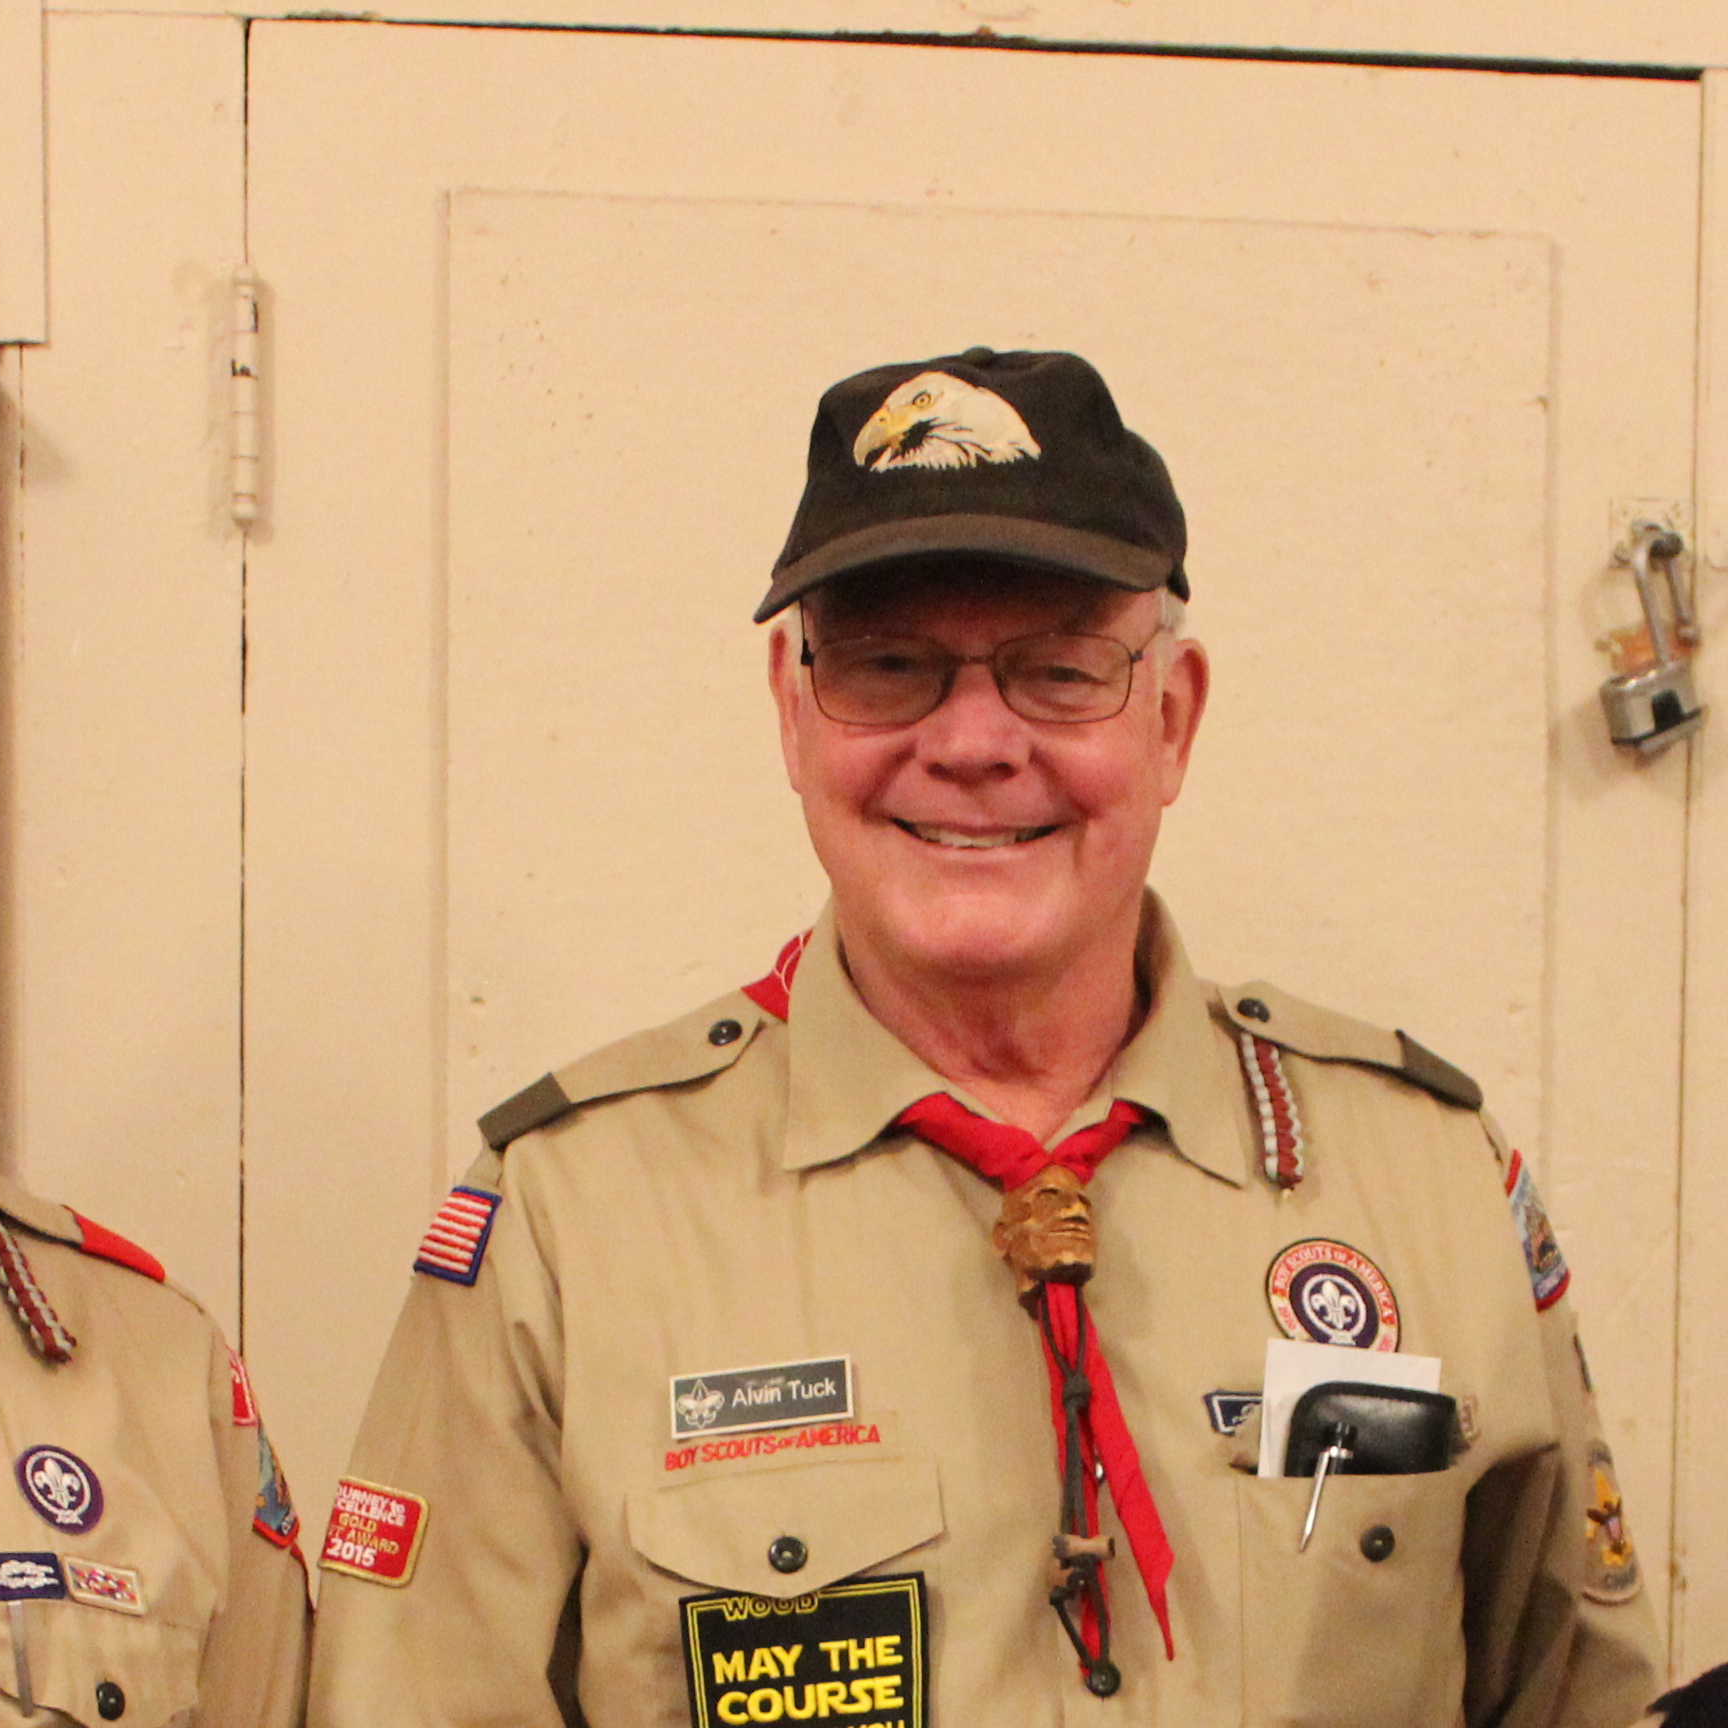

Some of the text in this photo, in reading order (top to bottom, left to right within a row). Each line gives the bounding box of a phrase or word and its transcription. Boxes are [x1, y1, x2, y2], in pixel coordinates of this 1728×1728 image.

[731, 1376, 838, 1409] Alvin Tuck
[664, 1446, 699, 1472] BOY
[700, 1433, 778, 1464] SCOUTS
[796, 1422, 882, 1450] AMERICA
[338, 1484, 390, 1508] URNEY
[335, 1496, 407, 1528] CELLENCE
[338, 1512, 378, 1534] GOLD
[325, 1537, 378, 1568] 2015
[346, 1528, 400, 1556] AWARD
[722, 1591, 820, 1622] WOOD
[711, 1634, 904, 1685] MAY THE
[716, 1674, 905, 1726] COURSE
